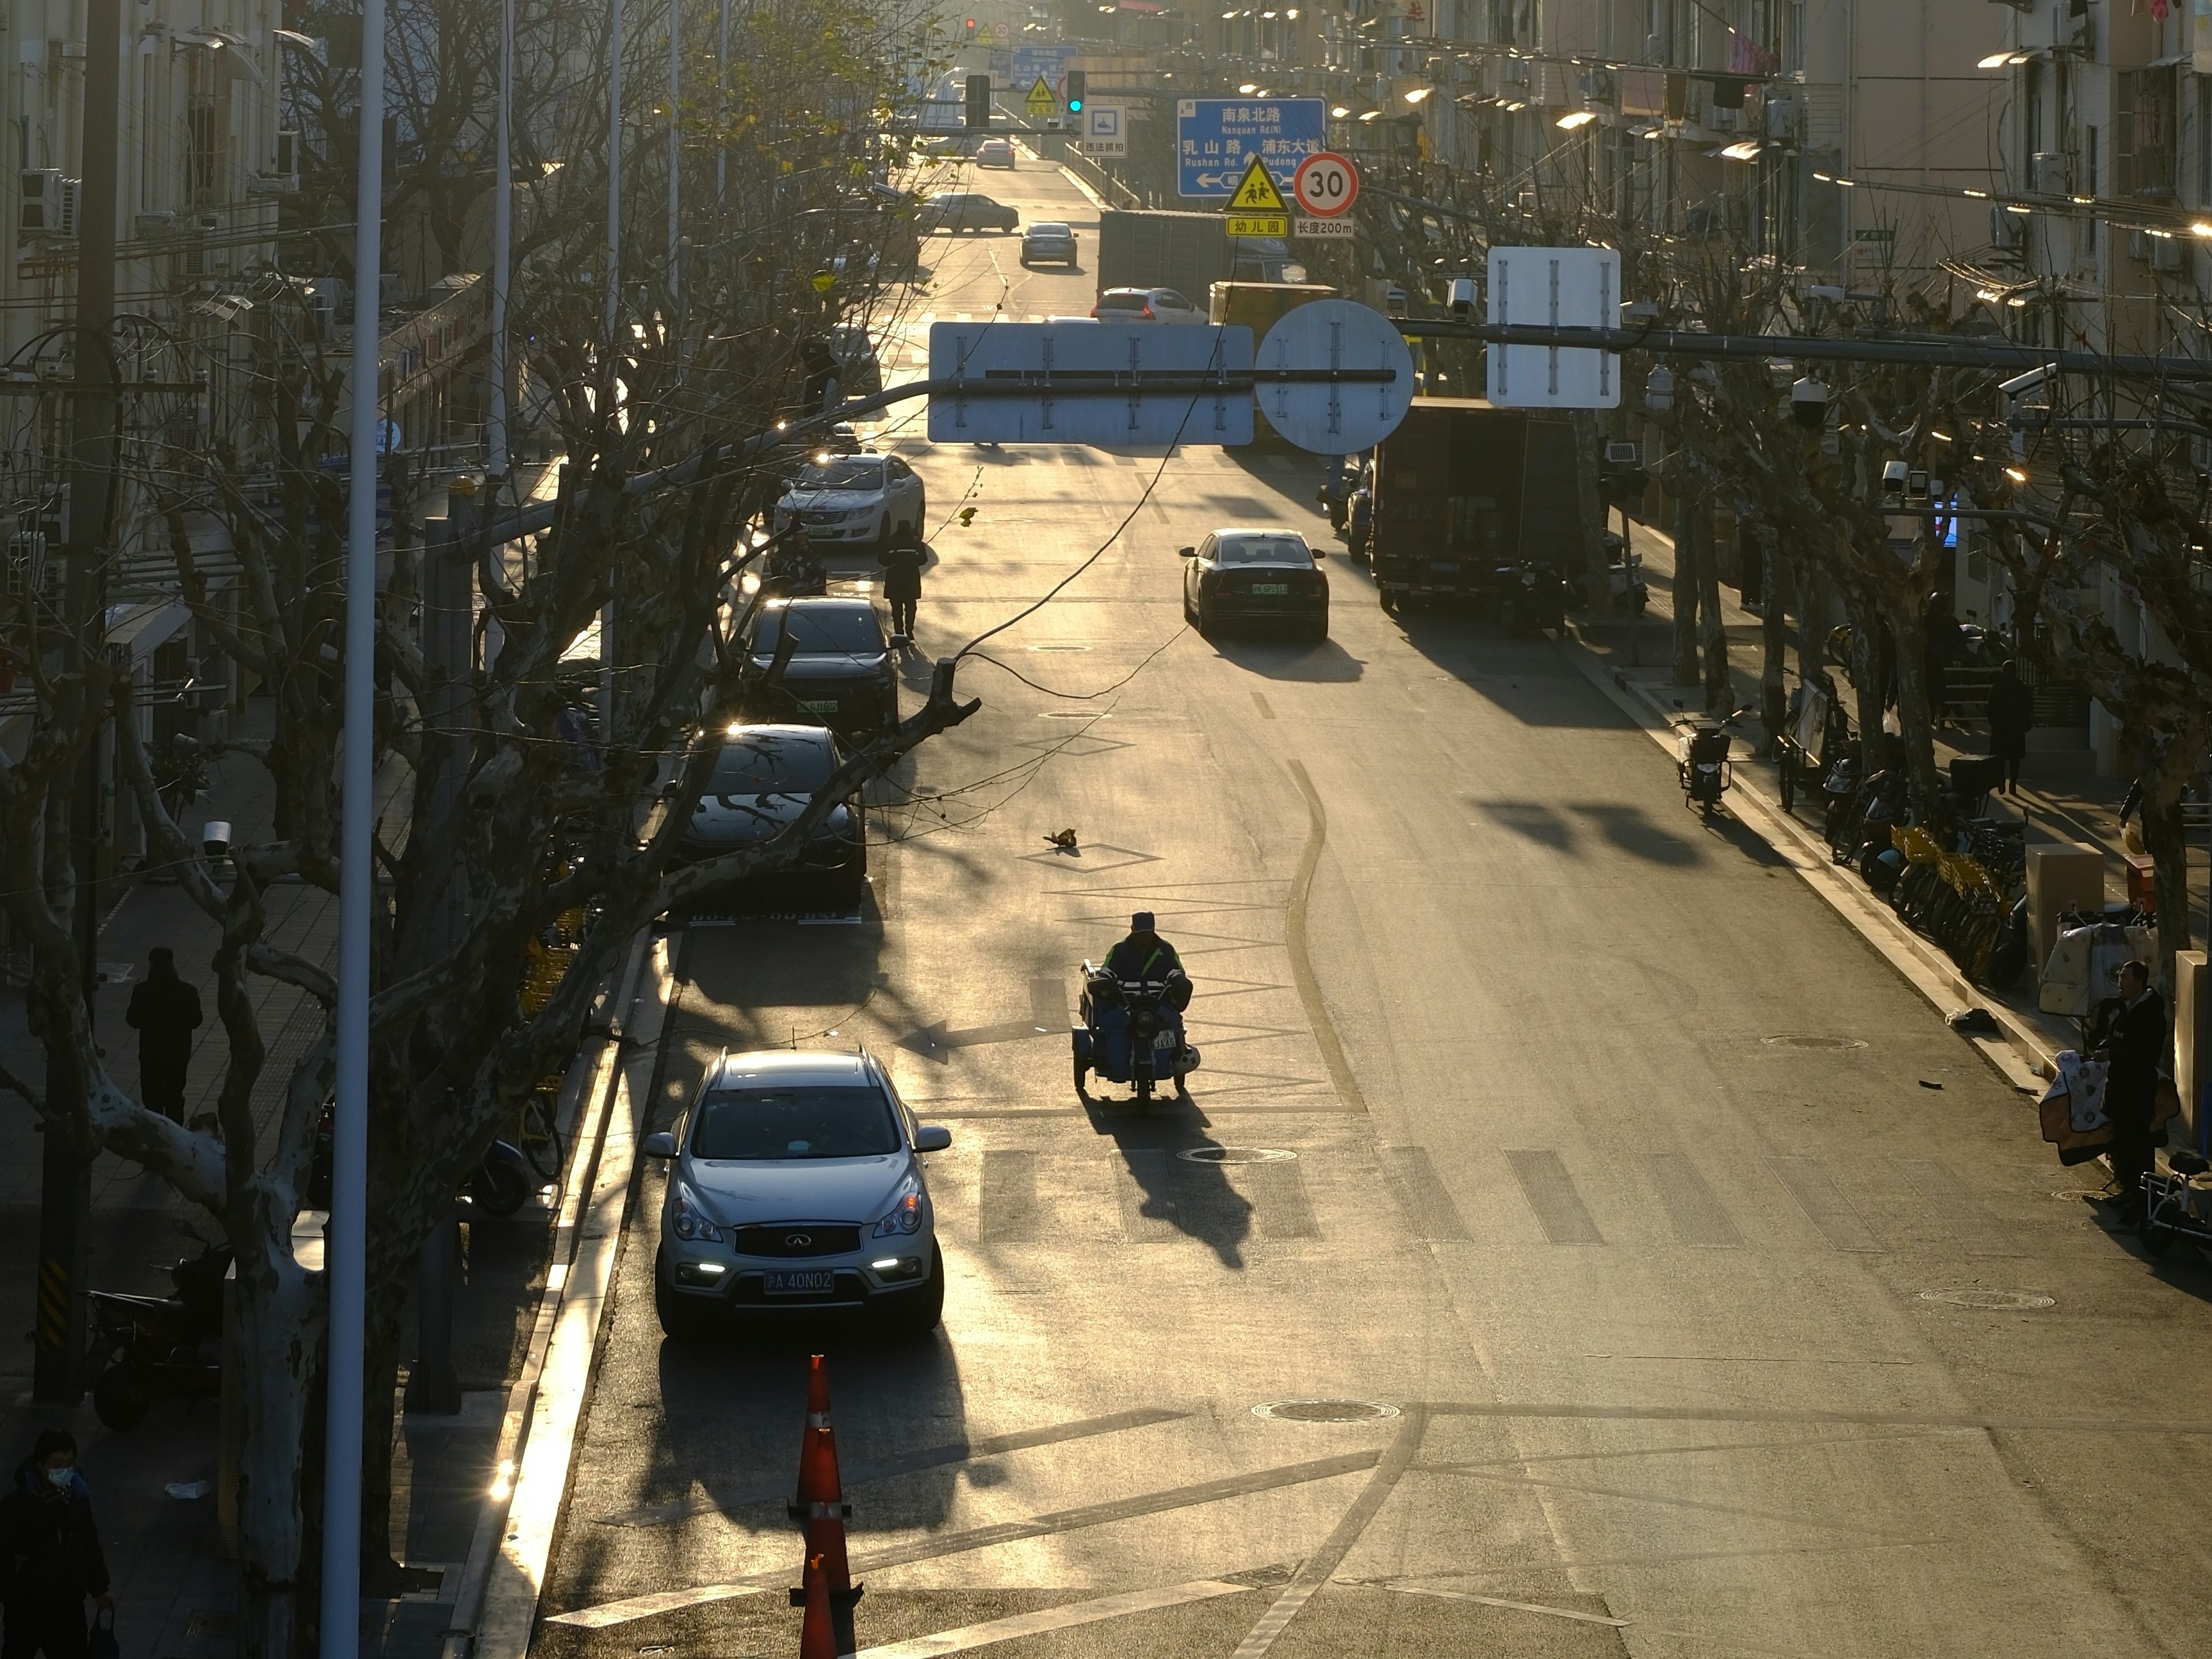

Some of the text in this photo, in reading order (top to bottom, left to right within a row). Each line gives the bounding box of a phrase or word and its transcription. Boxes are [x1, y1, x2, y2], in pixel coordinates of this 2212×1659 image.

[1222, 107, 1280, 122] 南泉北路
[1222, 126, 1256, 136] Nanquan
[1086, 142, 1123, 152] 违法抓拍
[1182, 139, 1241, 154] 乳山路
[1262, 138, 1319, 154] 浦东大道
[1185, 158, 1238, 167] Rushan Rd.
[1262, 158, 1296, 168] Pudong
[1309, 171, 1343, 198] 30
[1235, 220, 1279, 233] 幼儿园
[1297, 222, 1351, 234] 长度200m
